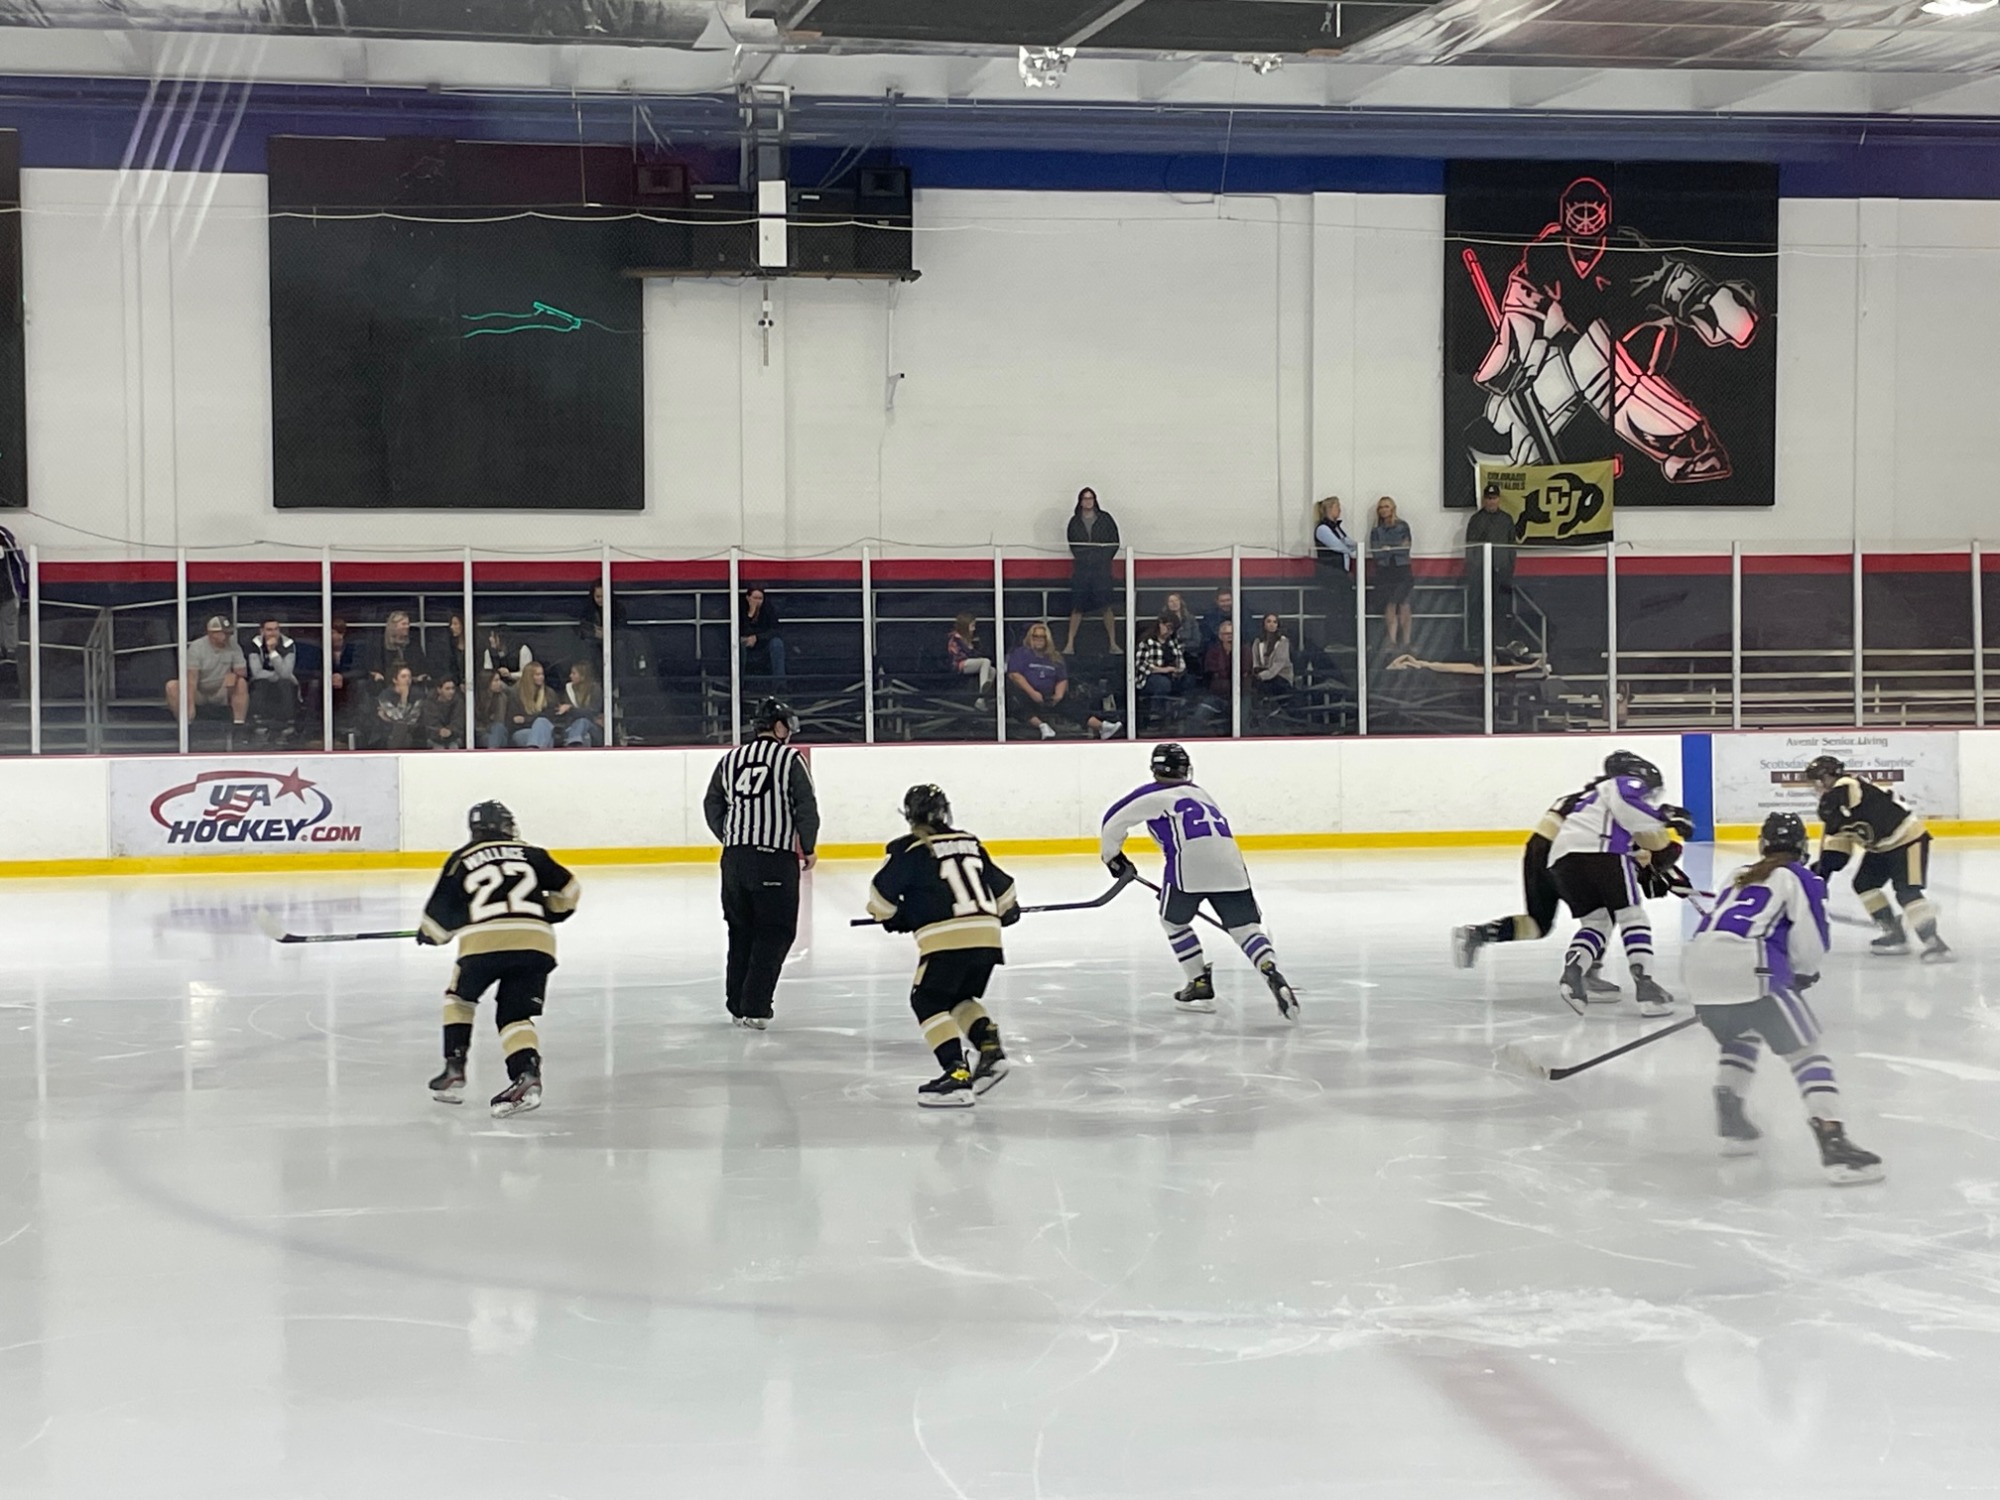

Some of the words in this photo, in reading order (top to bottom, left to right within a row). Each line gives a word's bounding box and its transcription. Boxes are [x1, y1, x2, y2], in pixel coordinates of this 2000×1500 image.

[1822, 737, 1854, 745] Senior
[1857, 736, 1888, 747] Living
[735, 766, 768, 795] 47
[207, 784, 271, 812] USA
[463, 860, 545, 923] 22
